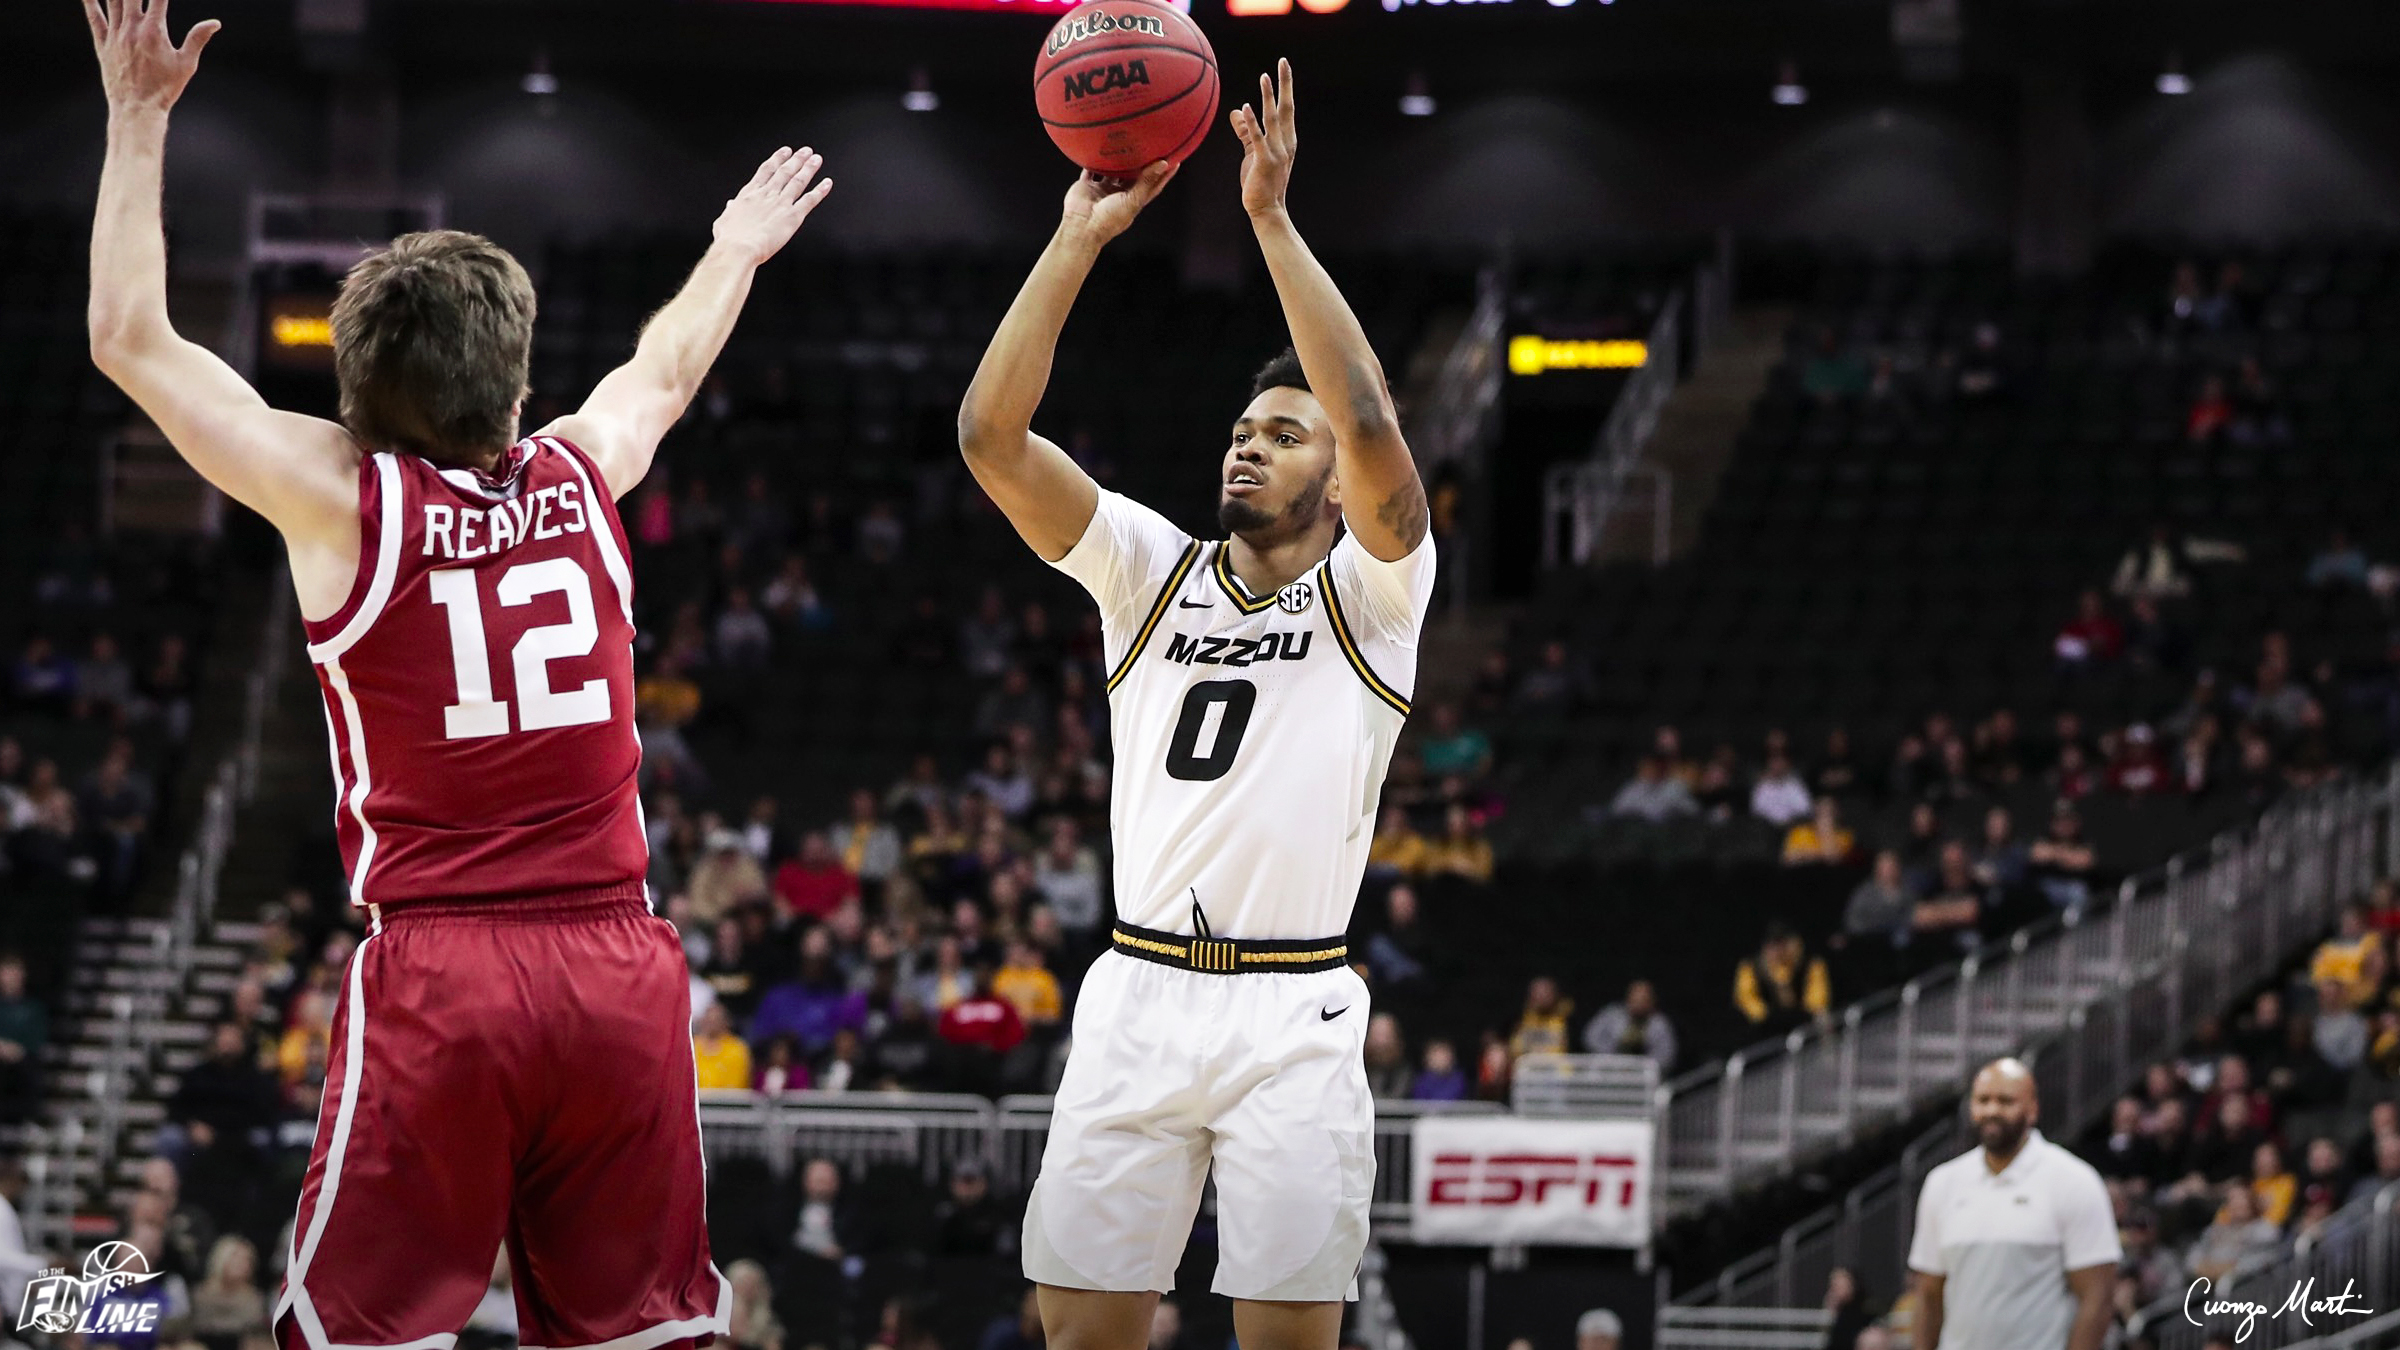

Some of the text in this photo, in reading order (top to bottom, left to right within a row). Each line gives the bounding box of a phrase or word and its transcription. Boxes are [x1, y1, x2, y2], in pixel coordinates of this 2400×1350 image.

[1047, 10, 1164, 57] Wilson
[1064, 59, 1150, 101] NCAA
[422, 481, 587, 559] REAVES
[1279, 584, 1311, 612] SEC
[429, 556, 612, 739] 12
[1166, 679, 1257, 781] 0
[1430, 1154, 1635, 1206] ESPN
